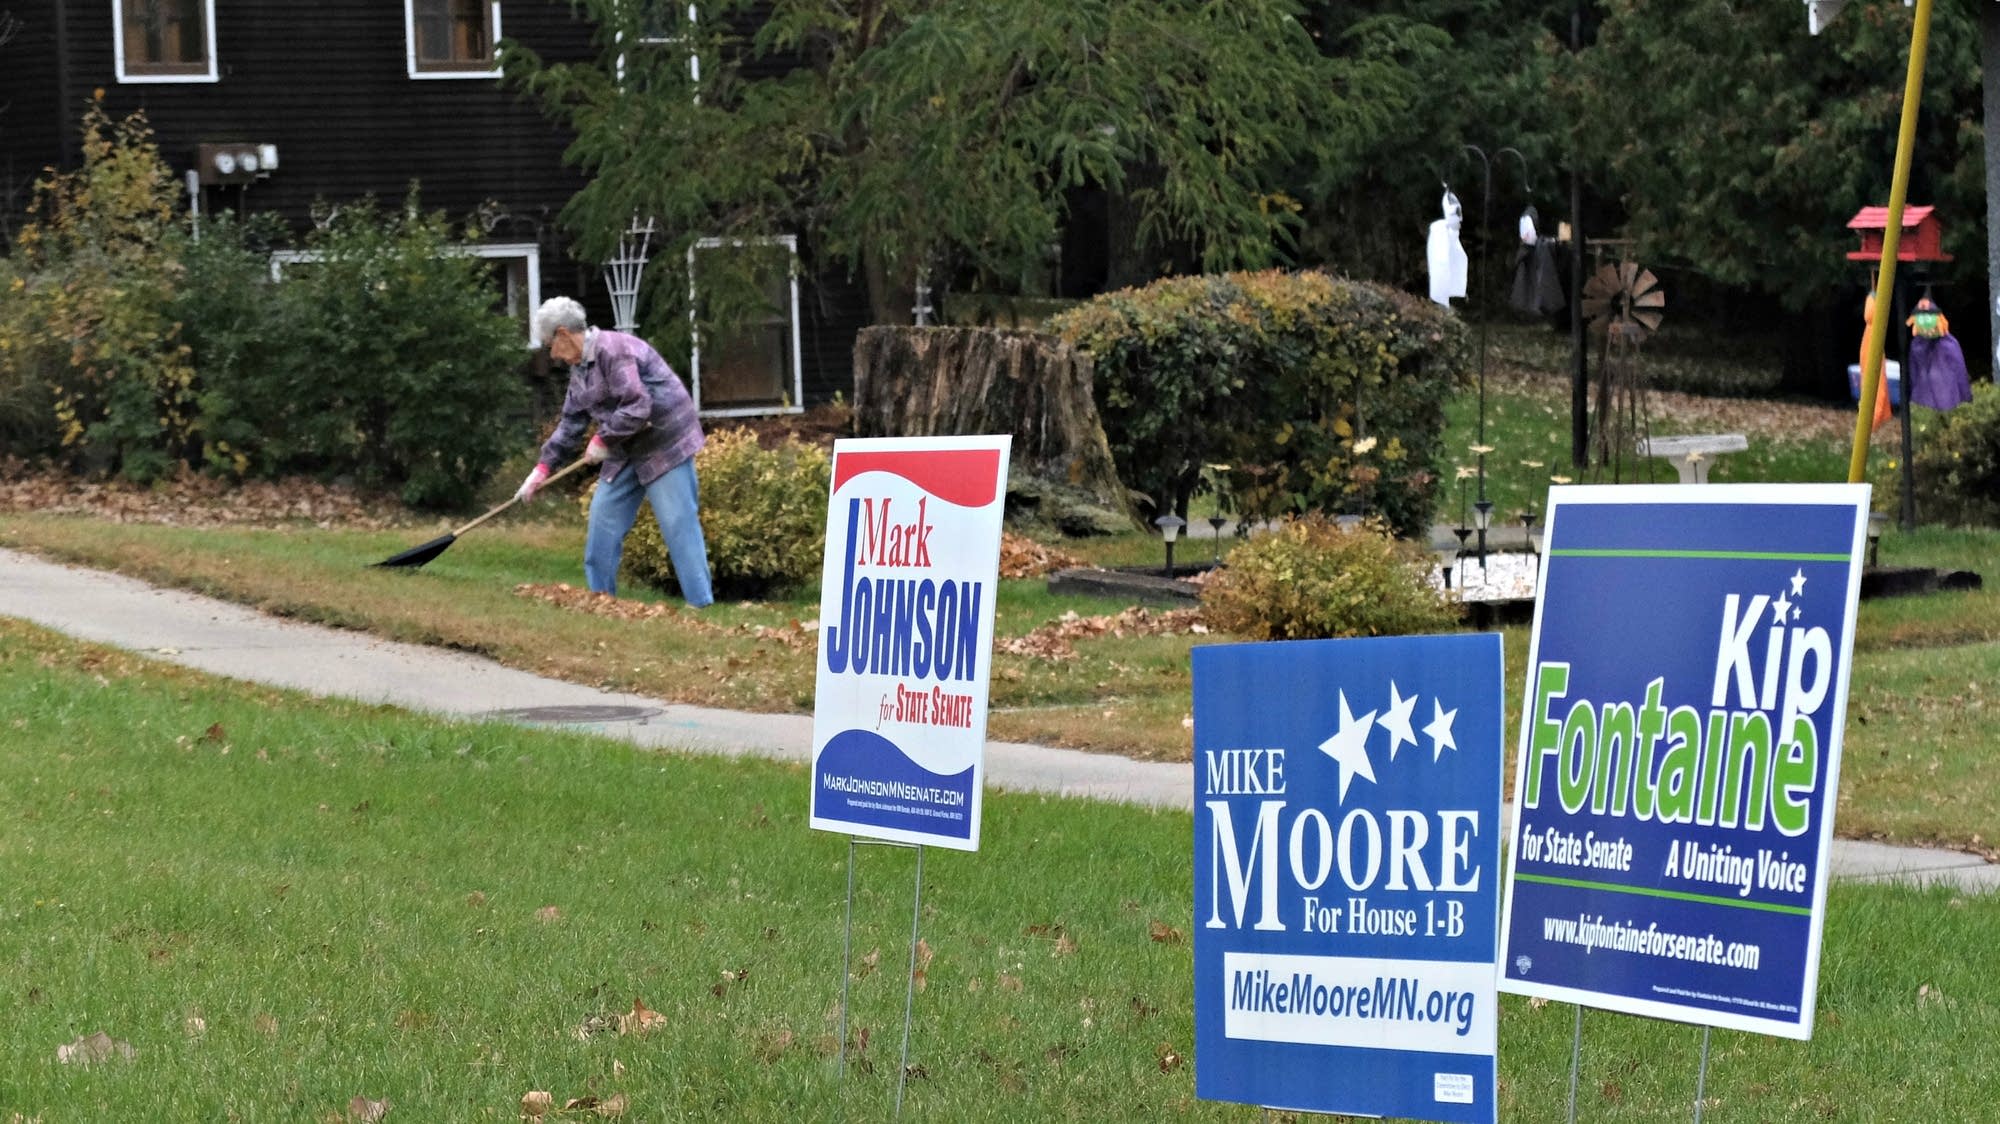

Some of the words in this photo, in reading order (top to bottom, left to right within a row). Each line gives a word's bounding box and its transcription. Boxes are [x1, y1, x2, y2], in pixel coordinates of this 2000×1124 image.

[858, 495, 934, 568] Mark
[827, 498, 982, 682] JOHNSON
[1712, 591, 1832, 745] Kip
[876, 693, 895, 731] for
[896, 683, 928, 724] STATE
[931, 685, 973, 728] SENATE
[1205, 748, 1287, 796] MIKE
[1524, 661, 1817, 837] Fontaine
[1205, 800, 1481, 932] MOORE
[1522, 824, 1543, 862] for
[1544, 826, 1581, 867] State
[1583, 831, 1633, 872] Senate
[1665, 839, 1679, 878] A
[1683, 840, 1754, 897] Uniting
[1758, 848, 1807, 893] Voice
[1303, 896, 1342, 934] For
[1347, 897, 1417, 936] House
[1424, 899, 1465, 937] 1-B
[1543, 913, 1760, 970] www.kipfontaineforsenate.com
[1231, 969, 1475, 1036] MikeMooreMN.org
